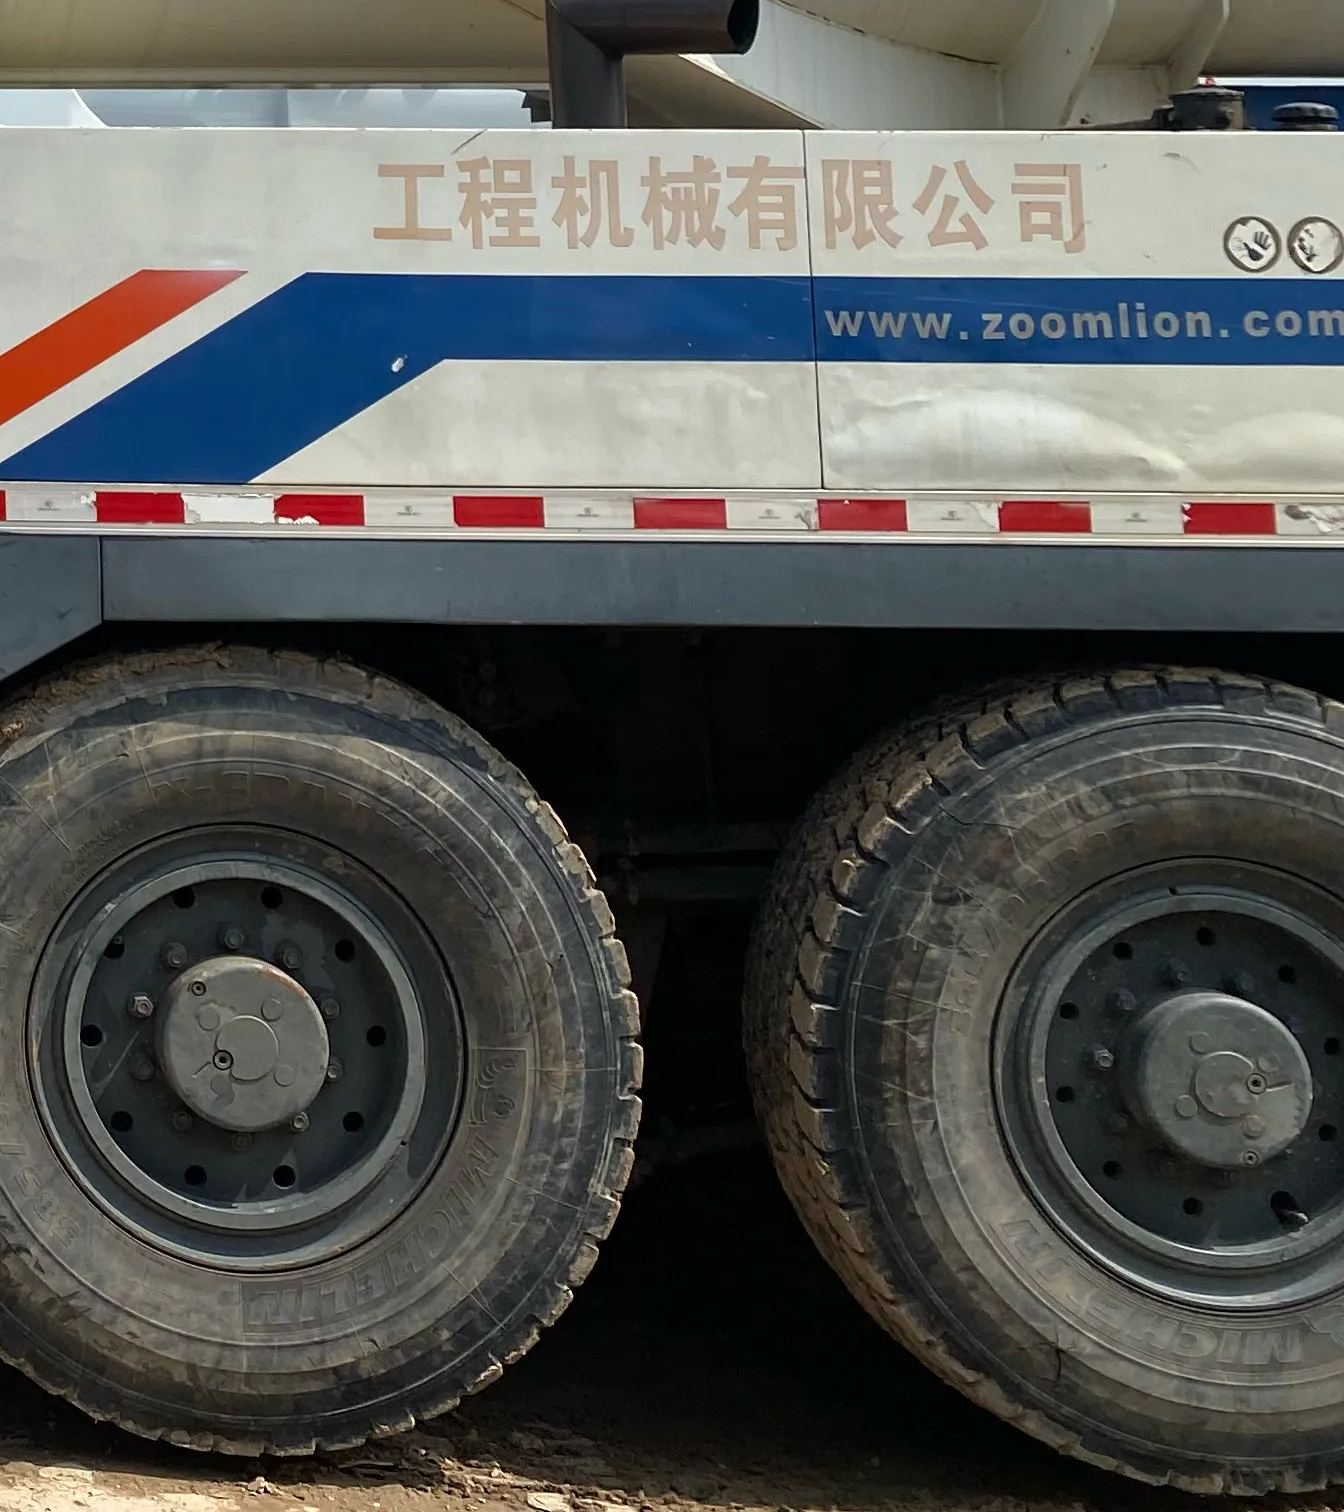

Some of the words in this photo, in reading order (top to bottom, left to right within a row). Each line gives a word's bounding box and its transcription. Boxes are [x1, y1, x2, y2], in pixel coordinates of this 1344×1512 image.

[372, 154, 1089, 256] 工程机械有限公司
